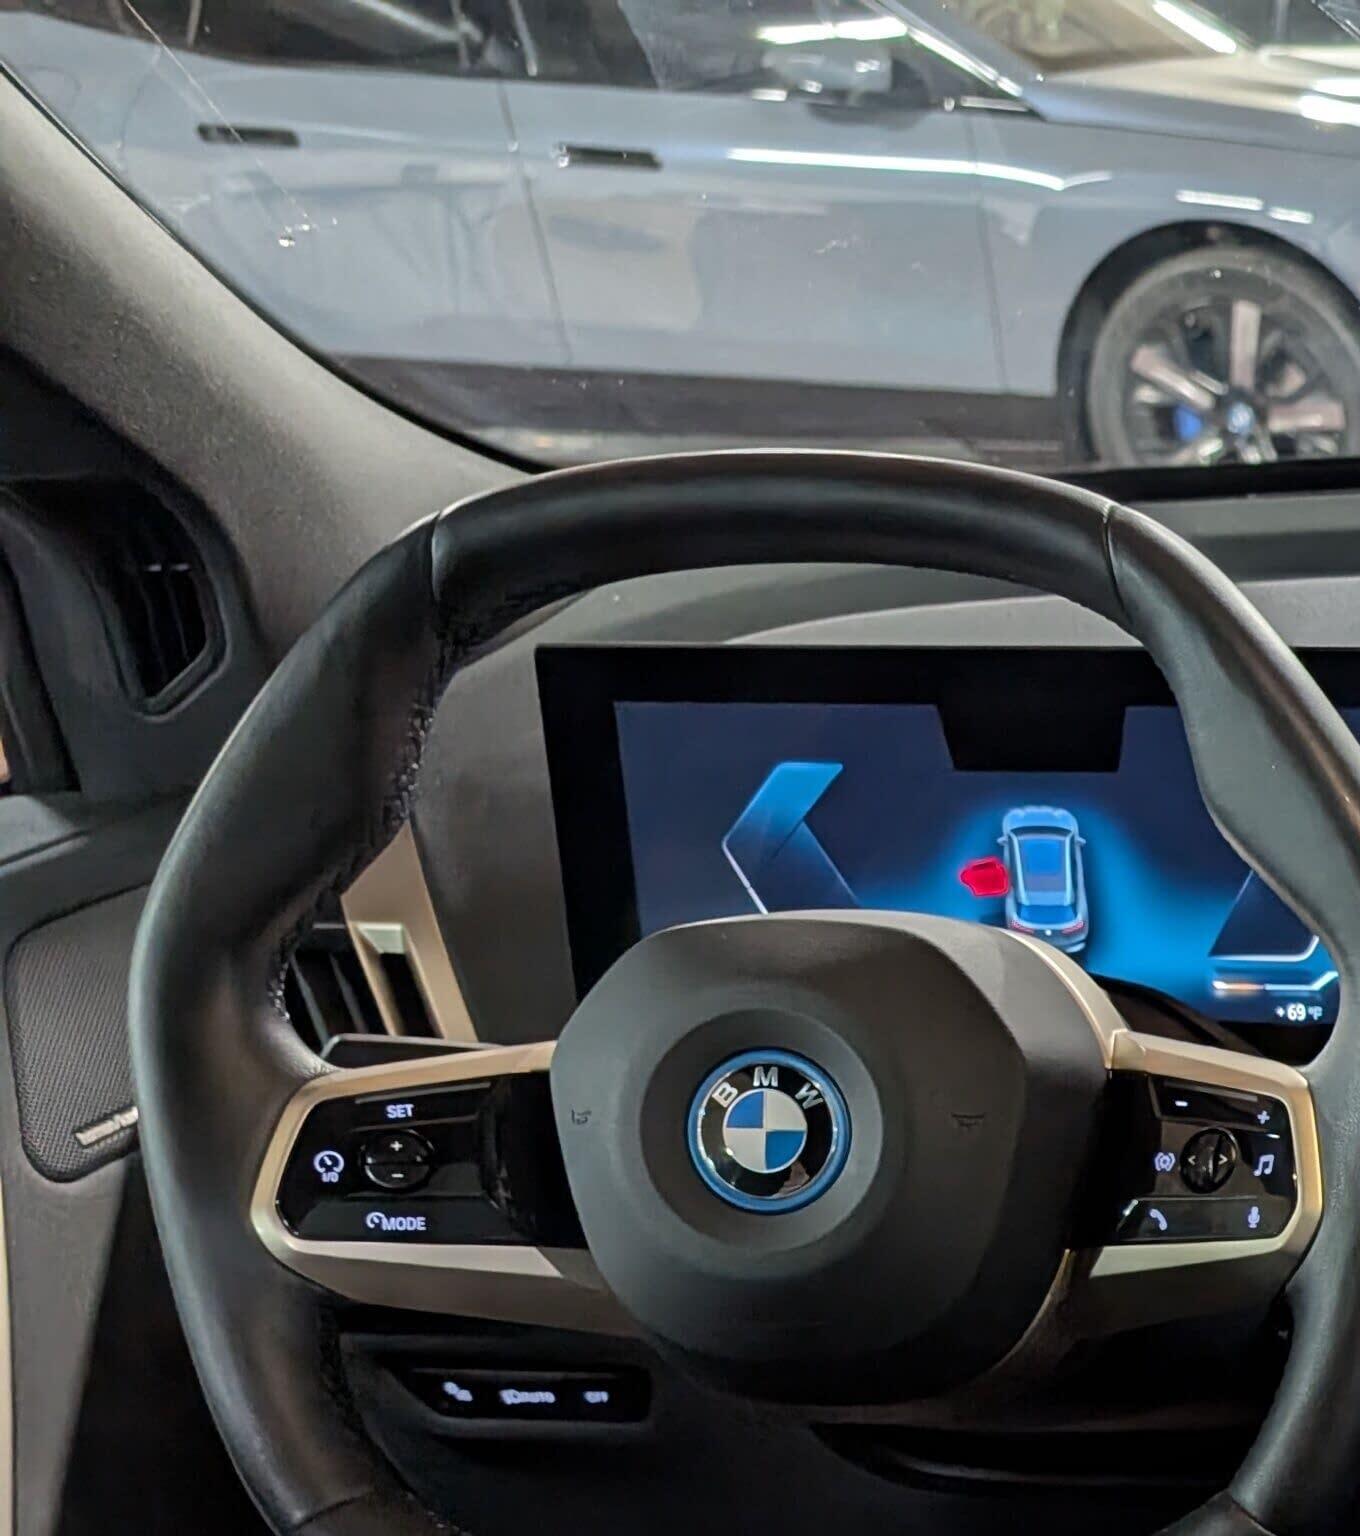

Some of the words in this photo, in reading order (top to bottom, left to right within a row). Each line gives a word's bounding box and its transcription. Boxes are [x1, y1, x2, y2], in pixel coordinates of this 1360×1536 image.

[711, 1066, 824, 1110] BMW
[386, 1104, 415, 1119] SET
[381, 1216, 427, 1232] MODE
